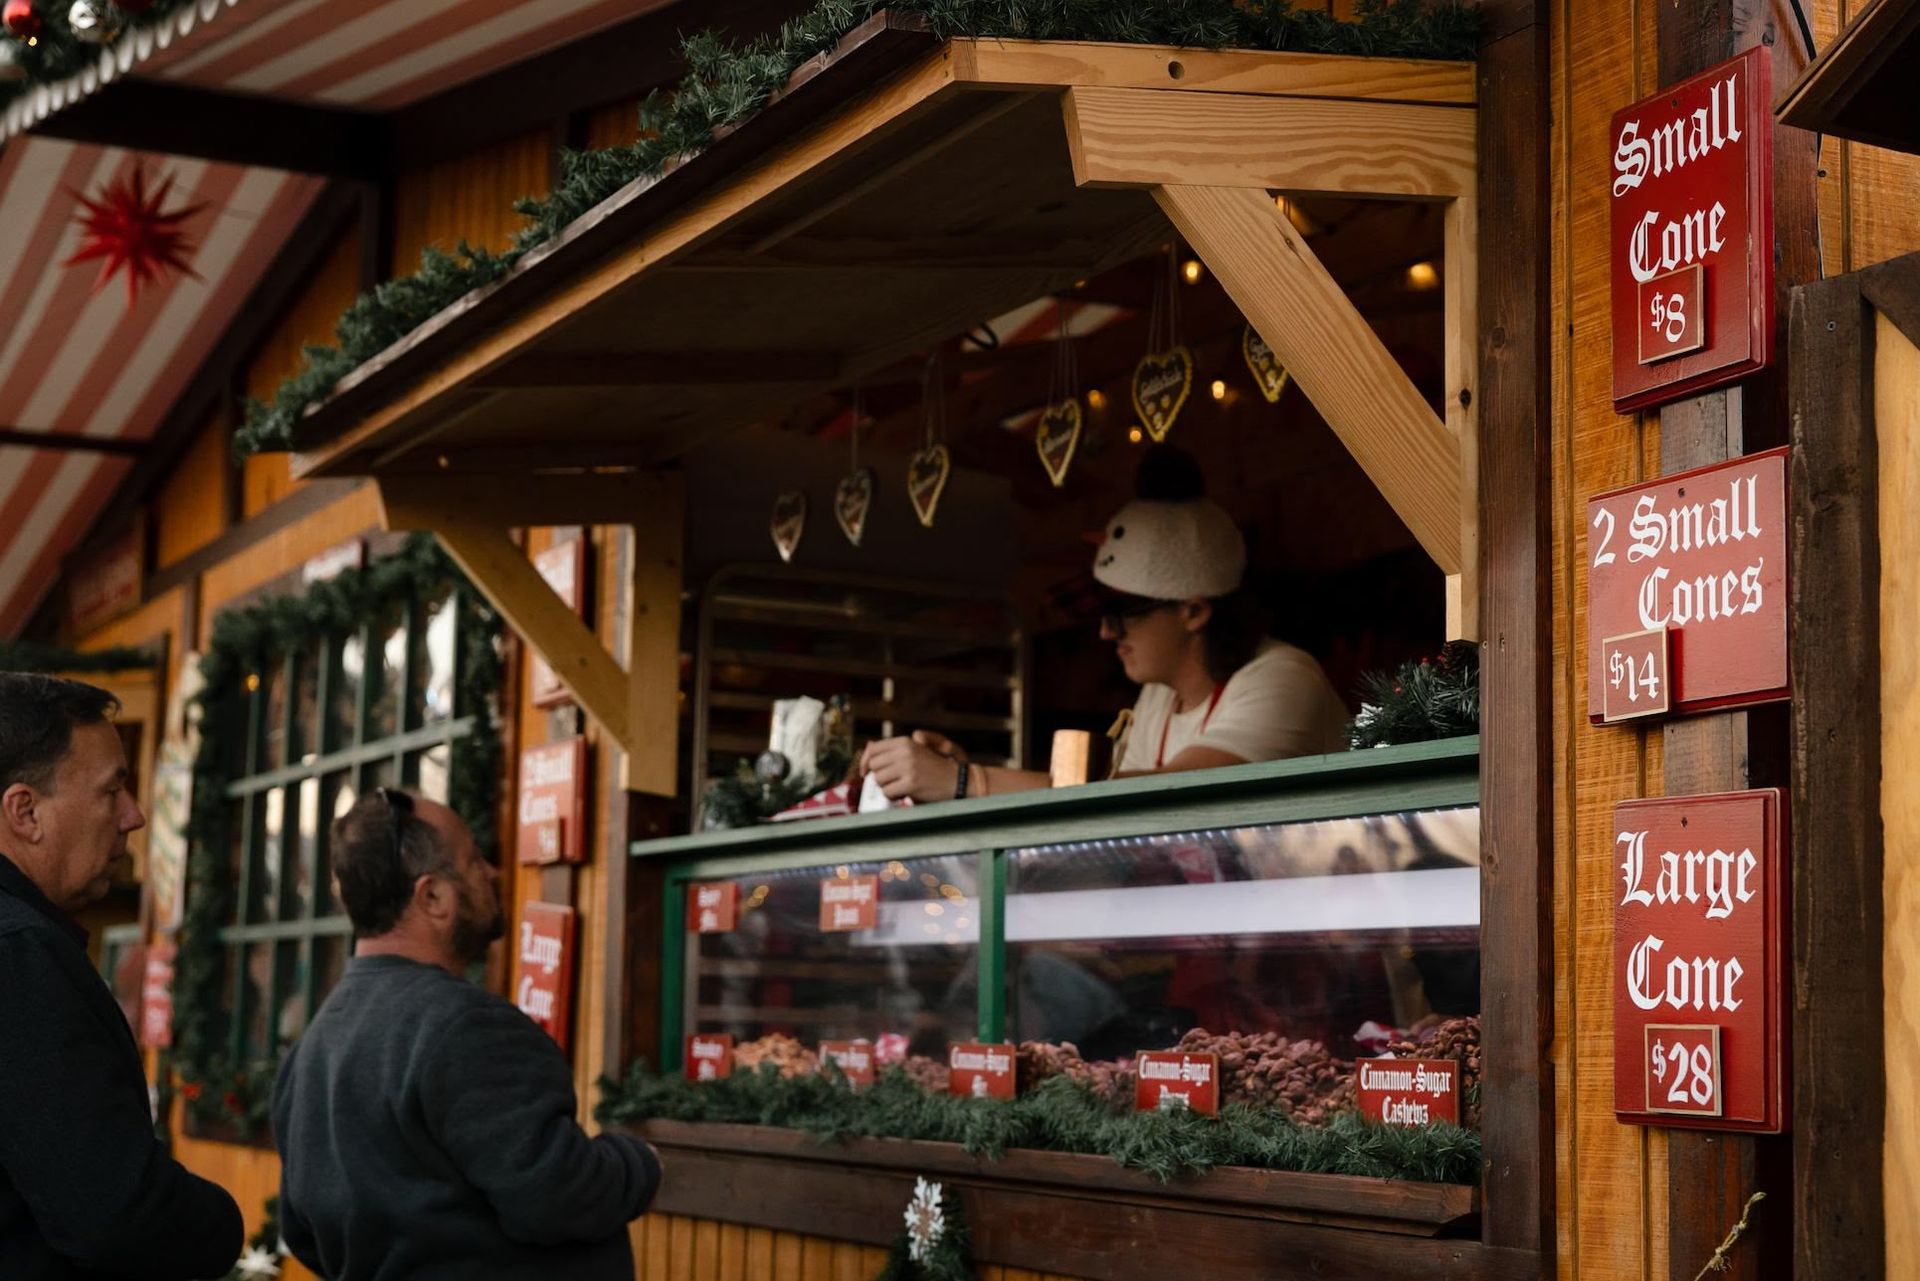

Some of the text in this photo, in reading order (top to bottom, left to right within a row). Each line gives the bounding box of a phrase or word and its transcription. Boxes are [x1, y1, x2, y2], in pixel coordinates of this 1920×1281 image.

[1613, 73, 1742, 197] Small
[1629, 200, 1726, 283] Cone
[1650, 291, 1686, 343] $8
[1593, 474, 1762, 568] 2 Small
[1638, 557, 1764, 631] Cones
[1610, 649, 1660, 702] $14
[1616, 830, 1757, 919] Large
[1626, 934, 1744, 1012] Cone
[1360, 1062, 1451, 1098] Cinnamon-Sugar
[1652, 1038, 1714, 1106] $28
